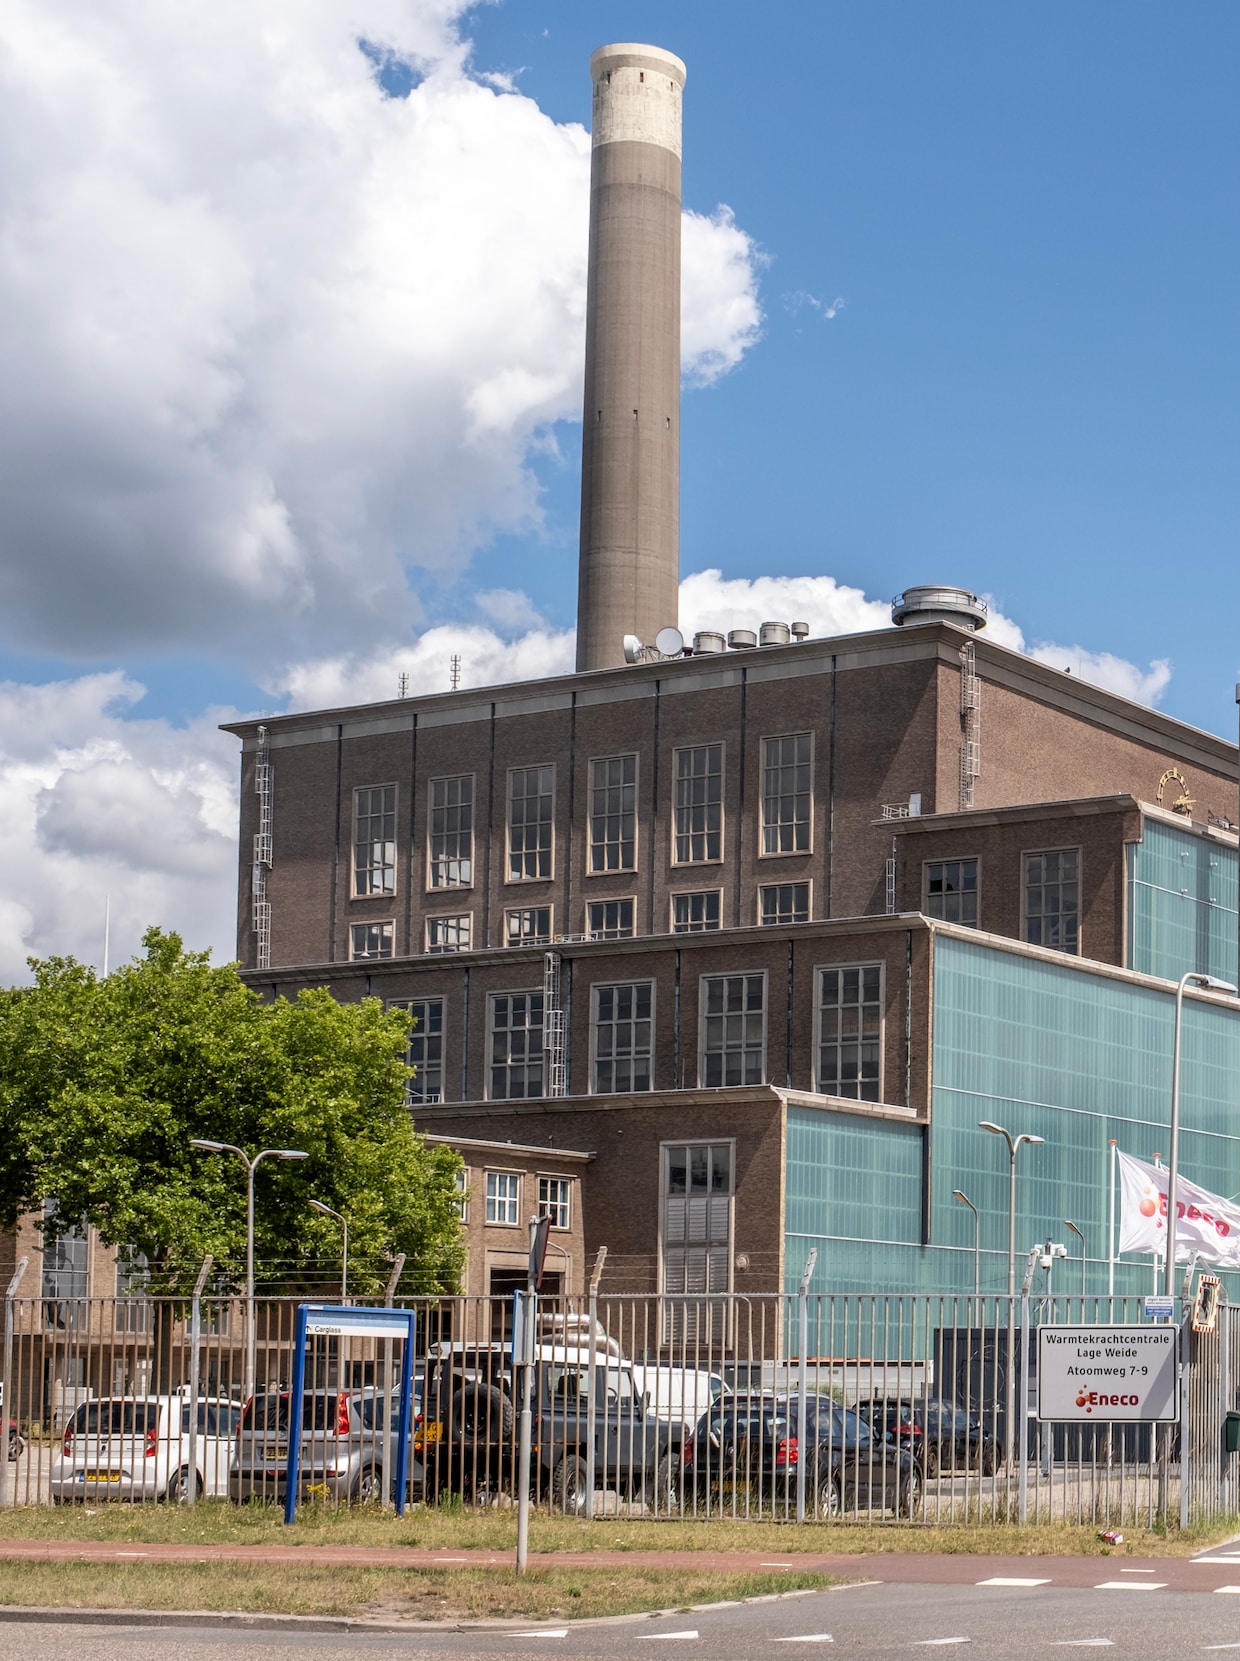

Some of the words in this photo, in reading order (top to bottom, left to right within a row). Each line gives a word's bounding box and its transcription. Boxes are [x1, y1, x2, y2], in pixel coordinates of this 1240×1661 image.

[314, 1325, 341, 1334] Carglass
[1046, 1334, 1170, 1344] Warmtekrachtcentrale
[1077, 1348, 1102, 1359] Lage
[1105, 1348, 1138, 1357] Weide
[1067, 1366, 1126, 1378] Atoomweg
[1129, 1366, 1148, 1375] 7-9
[1088, 1392, 1139, 1406] Eneco
